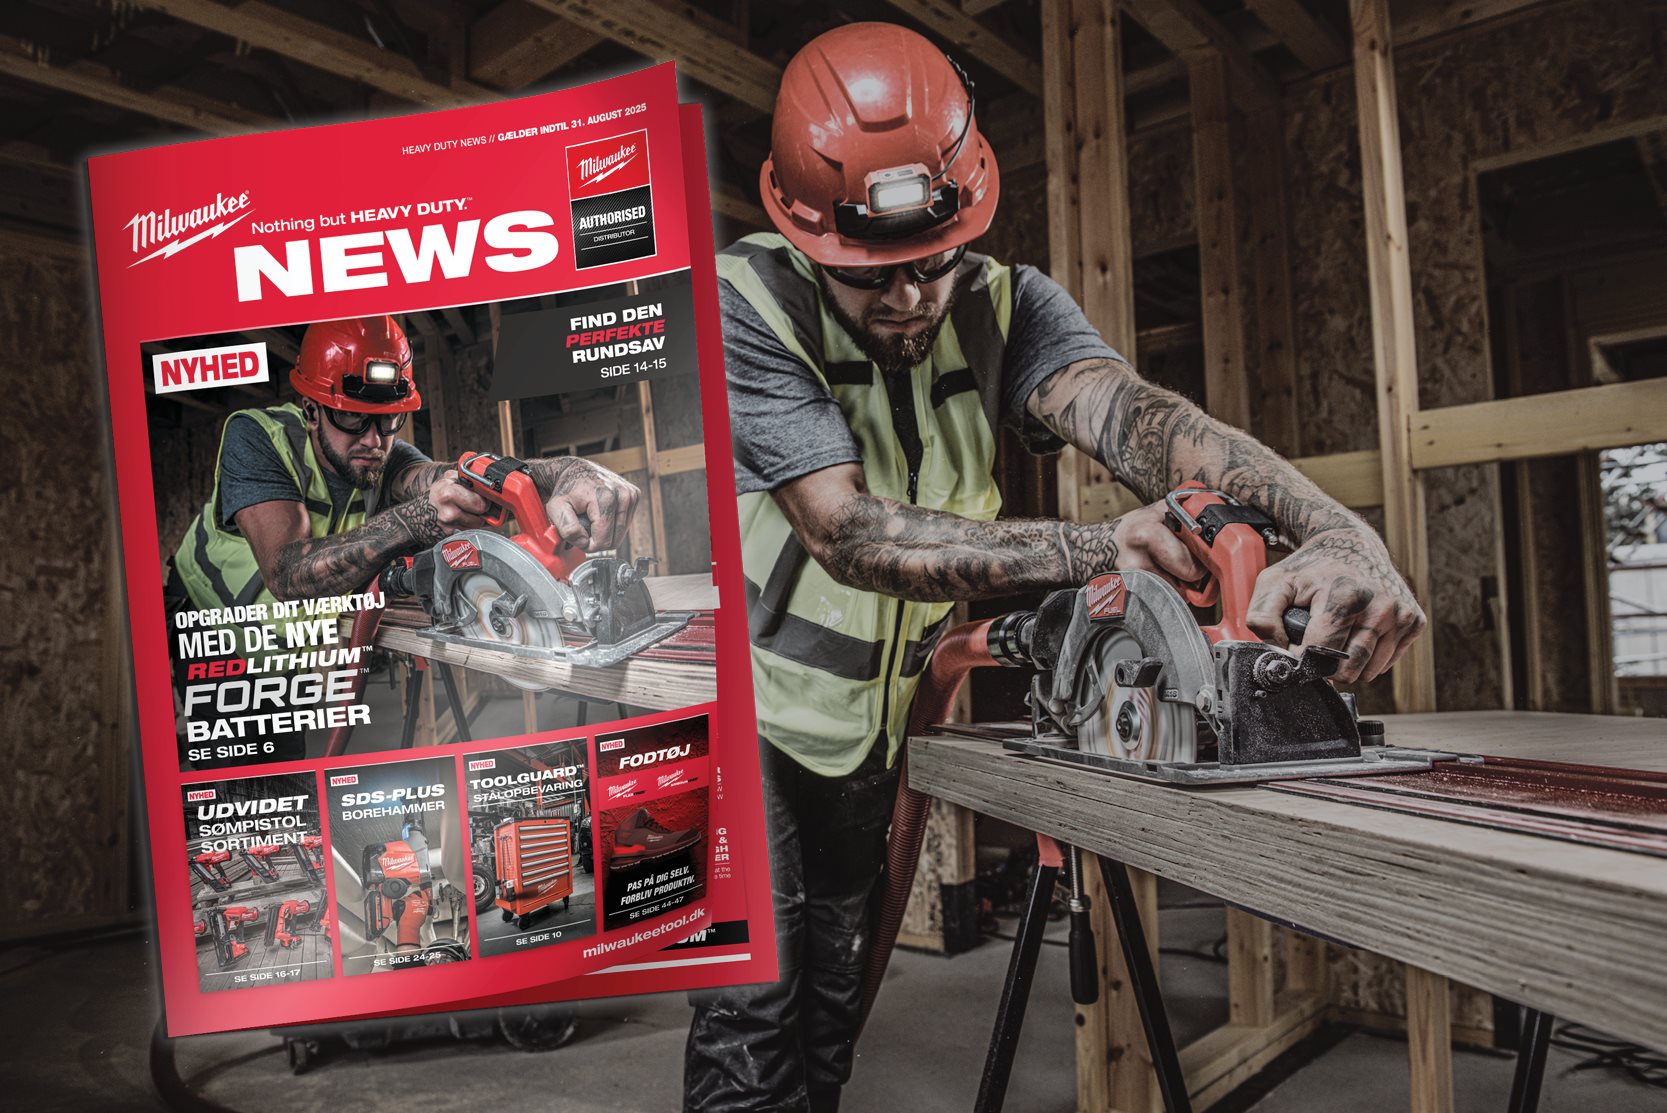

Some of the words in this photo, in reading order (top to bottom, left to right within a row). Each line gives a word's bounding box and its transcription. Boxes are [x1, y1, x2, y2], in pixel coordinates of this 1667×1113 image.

[402, 144, 431, 155] HEAVY
[434, 139, 458, 151] DUTY
[460, 136, 487, 147] NEWS
[497, 128, 538, 141] GÆLDER
[540, 122, 569, 135] INDTIL
[571, 119, 585, 129] 31.
[587, 110, 622, 125] AUGUST
[624, 103, 647, 116] 2025
[251, 216, 315, 235] Nothing
[320, 213, 346, 227] but
[351, 205, 412, 223] HEAVY
[579, 206, 646, 229] AUTHORISED
[593, 229, 635, 242] DISTRIBUTOR
[233, 210, 559, 302] NEWS
[570, 312, 617, 331] FIND
[622, 303, 663, 323] DEN
[565, 319, 666, 348] PERFEKTE
[572, 336, 666, 364] RUNDSAV
[160, 351, 259, 387] NYHED
[600, 364, 631, 378] SIDE
[633, 358, 667, 373] 14-15
[175, 603, 268, 629] OPGRADER
[273, 601, 299, 619] DIT
[302, 591, 386, 616] VÆRKTØJ
[178, 628, 237, 660] MED
[244, 624, 279, 653] DE
[286, 619, 339, 649] NYE
[187, 705, 371, 743] BATTERIER
[188, 749, 212, 761] SE
[216, 743, 258, 758] SIDE
[263, 741, 275, 753] 6
[601, 741, 623, 750] NYHED
[619, 744, 690, 770] FODTØJ
[470, 760, 494, 769] NYHED
[332, 776, 357, 786] NYHED
[473, 779, 583, 803] STÅLOPBEVARING
[189, 791, 214, 800] NYHED
[341, 783, 445, 807] SDS-PLUS
[197, 794, 309, 821] UDVIDET
[342, 800, 445, 821] BOREHAMMER
[199, 815, 307, 837] SØMPISTOL
[201, 831, 308, 854] SORTIMENT
[627, 881, 642, 892] PAS
[643, 875, 655, 887] PÅ
[656, 871, 669, 884] DIG
[620, 890, 652, 906] FORBLIV
[629, 910, 640, 920] SE
[643, 904, 661, 917] SIDE
[661, 896, 684, 909] 44-47
[516, 938, 528, 946] SE
[530, 934, 550, 944] SIDE
[552, 931, 562, 939] 10
[583, 906, 705, 959] milwaukeetool.dk
[374, 958, 387, 967] SE
[389, 955, 411, 965] SIDE
[413, 951, 441, 961] 24-25
[234, 975, 248, 983] SE
[250, 972, 273, 982] SIDE
[275, 969, 301, 979] 16-17
